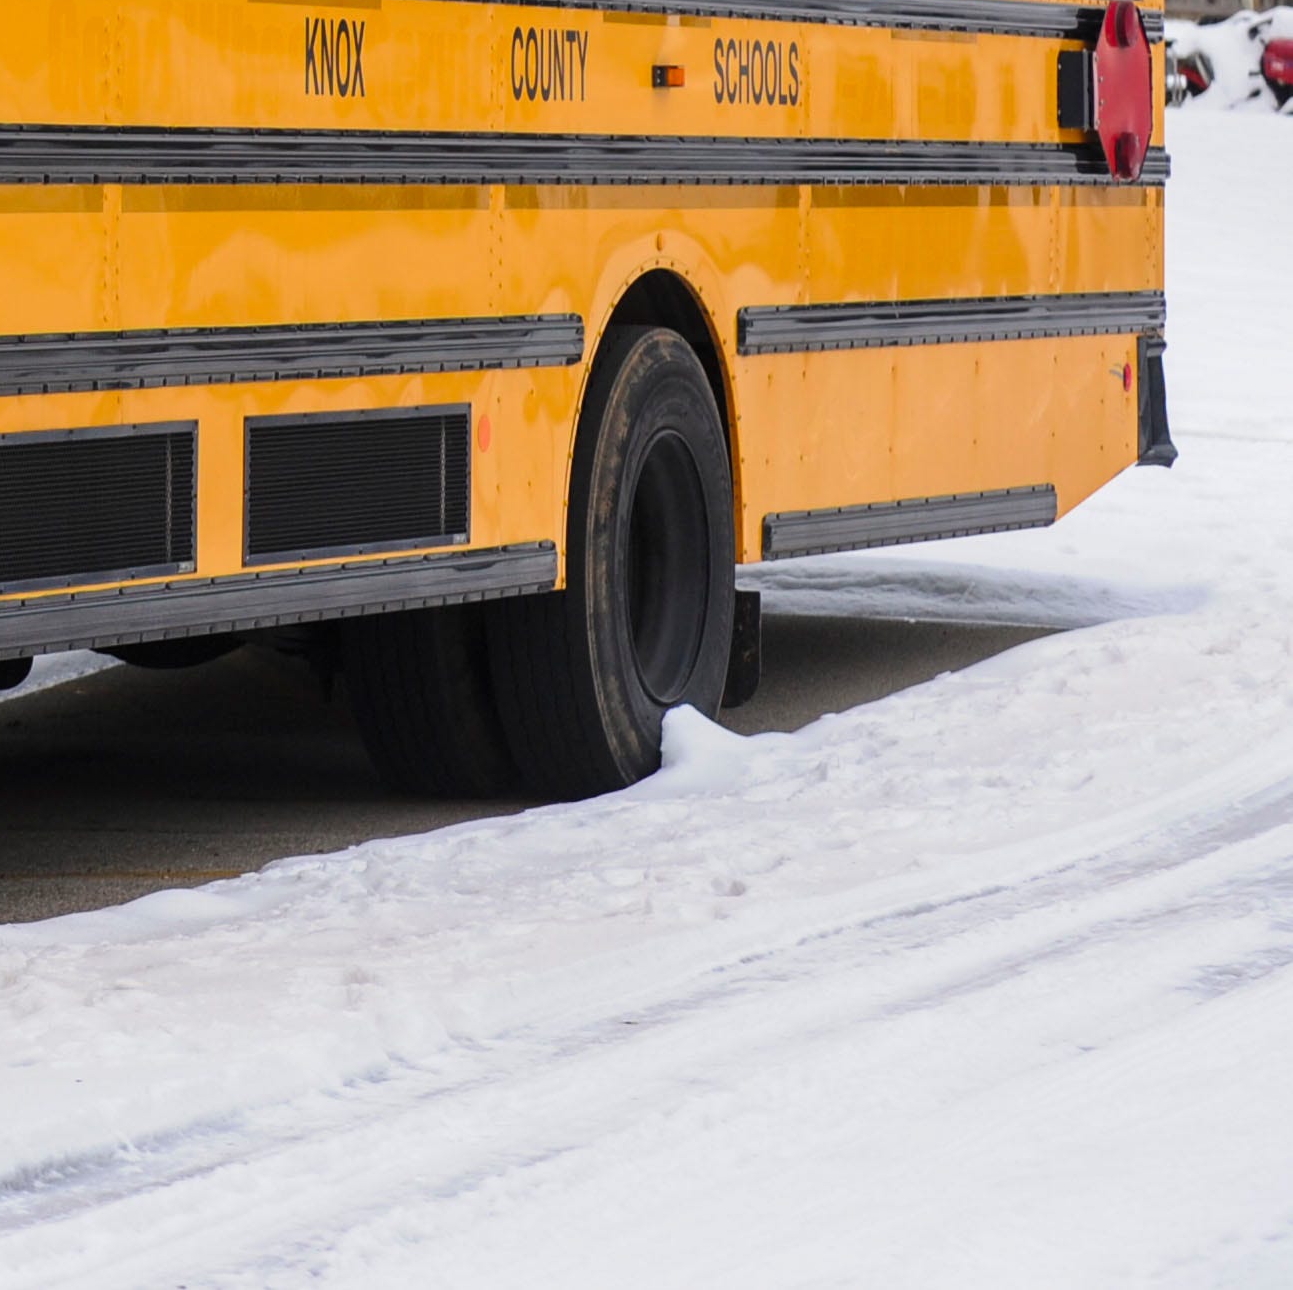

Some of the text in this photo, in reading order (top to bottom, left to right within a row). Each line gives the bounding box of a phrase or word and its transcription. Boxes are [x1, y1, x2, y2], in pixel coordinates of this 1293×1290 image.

[304, 17, 800, 106] KNOX COUNTY SCHOOLS
